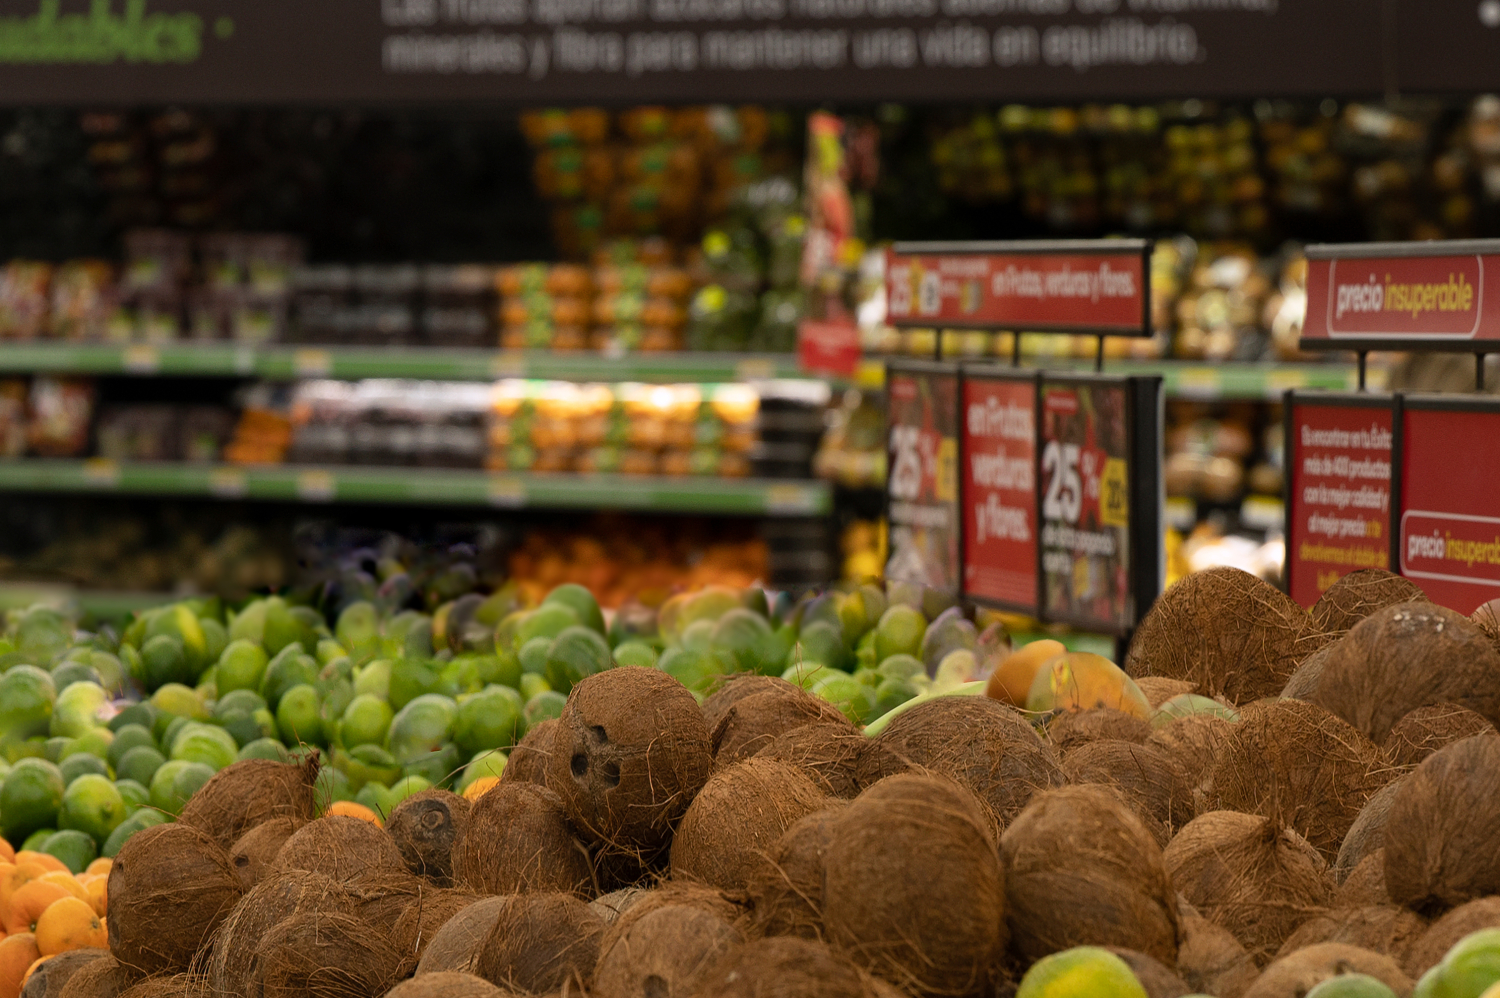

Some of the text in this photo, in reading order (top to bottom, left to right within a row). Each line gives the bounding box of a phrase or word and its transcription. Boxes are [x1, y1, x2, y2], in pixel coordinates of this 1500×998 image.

[382, 31, 527, 72] minerales
[529, 36, 550, 79] y
[554, 28, 622, 71] fibra
[627, 33, 697, 77] para
[703, 29, 848, 70] mantener
[852, 28, 915, 68] una
[921, 21, 989, 67] vida
[994, 27, 1038, 65] en
[1336, 273, 1473, 320] precio insuperable
[1312, 427, 1349, 448] encontrar
[1349, 431, 1361, 449] en
[1361, 428, 1371, 449] tu
[970, 446, 1033, 491] verduras
[1303, 453, 1321, 476] más
[1321, 454, 1333, 476] de
[1349, 456, 1391, 481] productos
[1303, 482, 1390, 514] con la mejor calidad y
[975, 503, 988, 545] y
[1319, 511, 1340, 539] mejor
[1340, 513, 1366, 539] precio
[1408, 528, 1445, 562] precio
